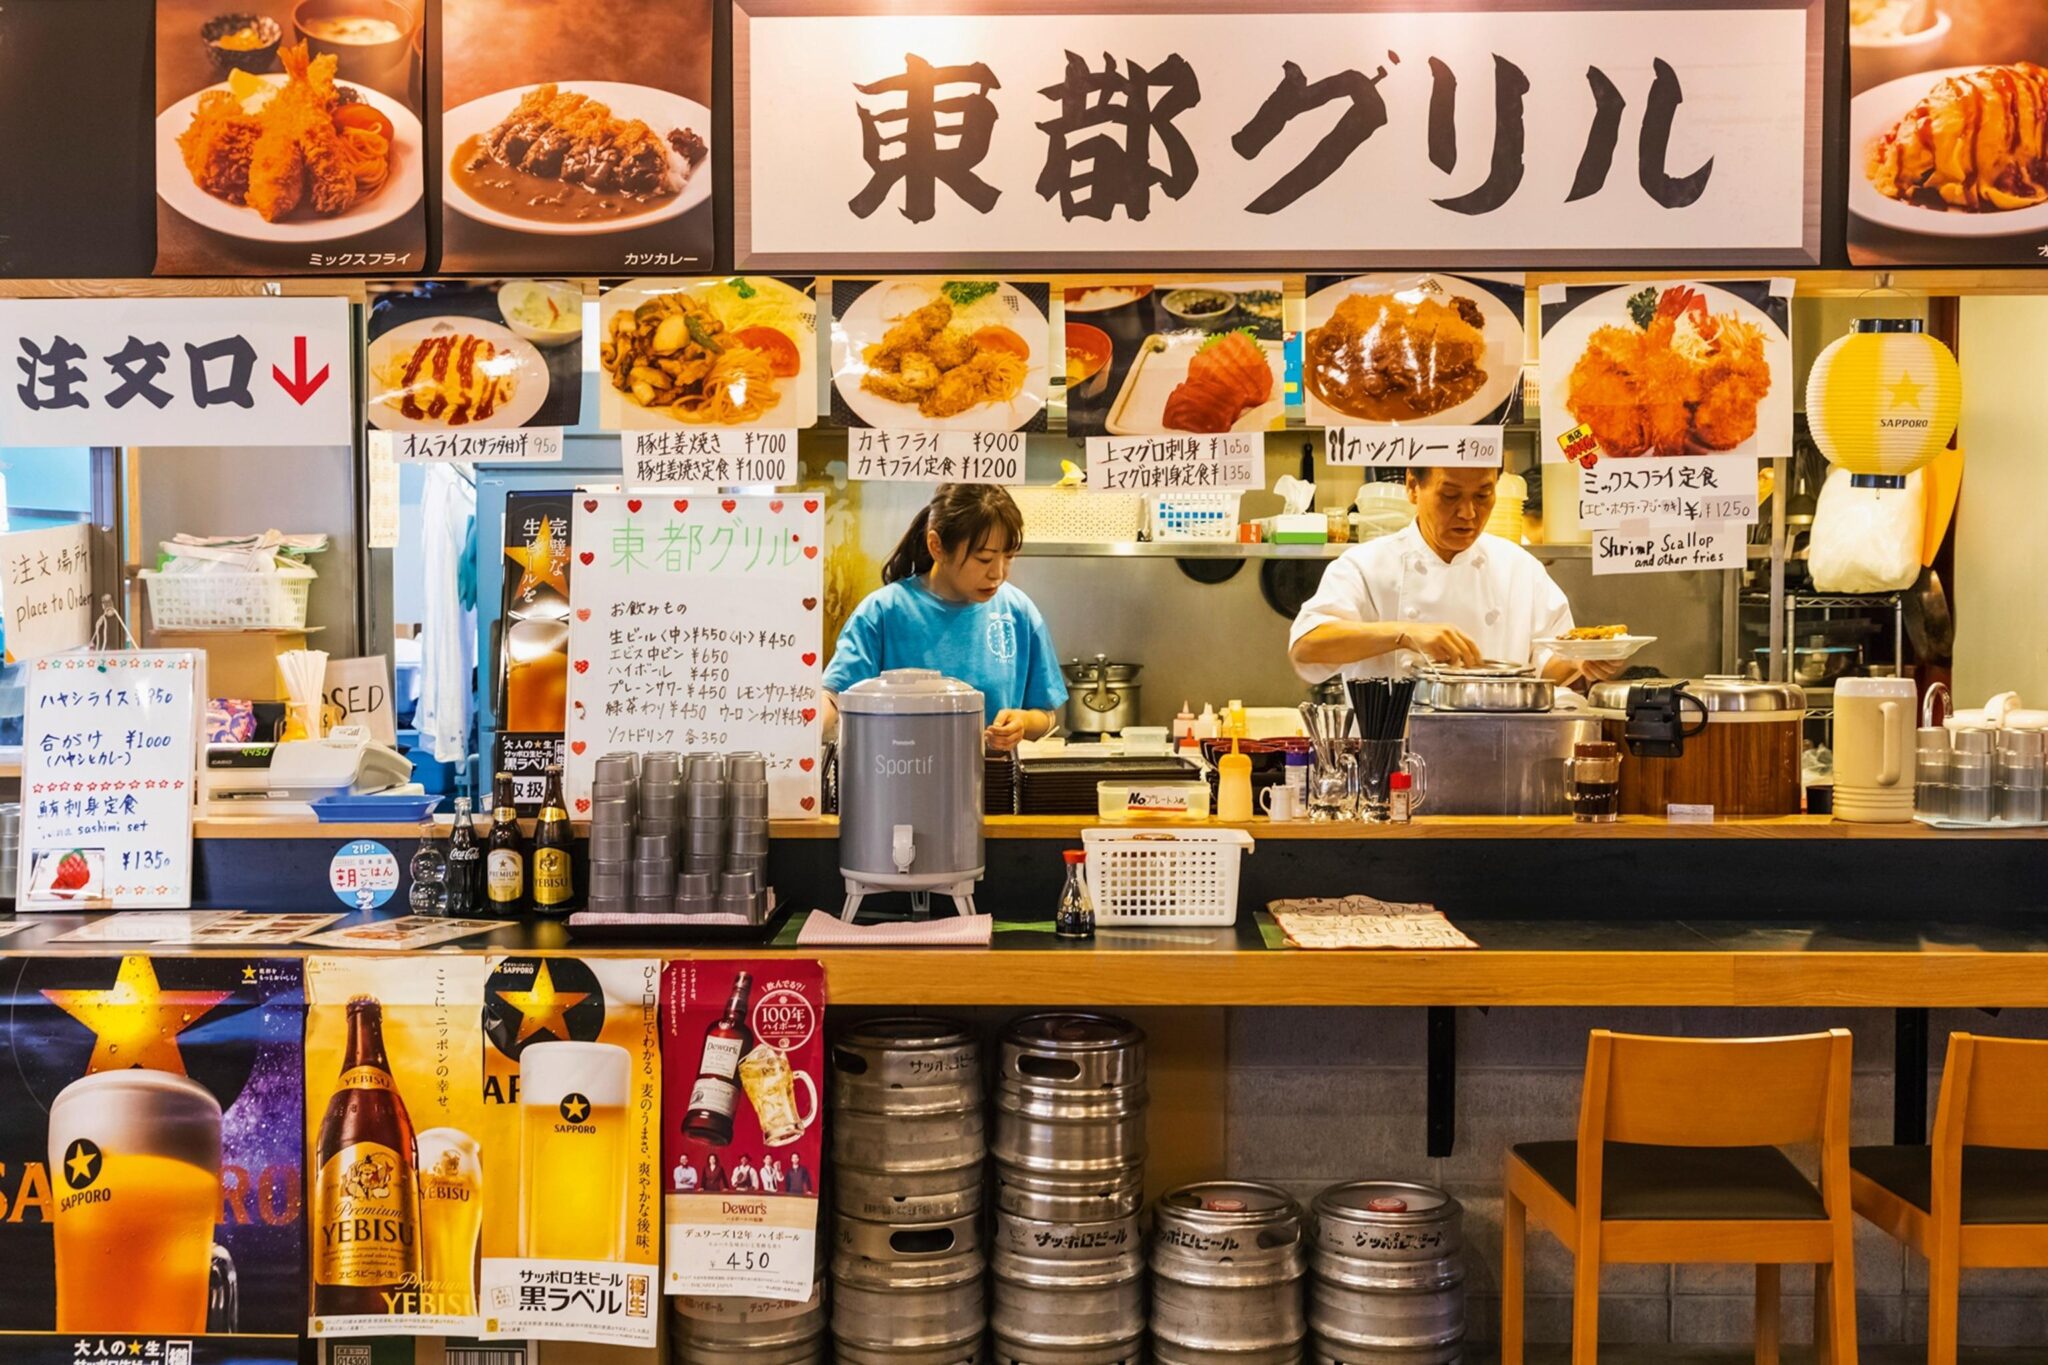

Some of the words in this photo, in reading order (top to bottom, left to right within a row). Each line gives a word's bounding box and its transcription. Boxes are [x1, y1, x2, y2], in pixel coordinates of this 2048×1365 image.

[848, 50, 1714, 224] 東都グリル
[308, 252, 411, 266] ミックスフライ
[624, 252, 698, 265] カツカレー
[17, 335, 257, 411] 注文口
[1880, 418, 1928, 428] SAPPORO
[636, 431, 721, 456] 豚生姜焼き
[744, 432, 786, 454] ¥700
[857, 431, 939, 452] カキフライ
[973, 432, 1019, 453] ¥900
[1101, 438, 1200, 464] 上マグロ刺身
[1346, 432, 1449, 462] カツカレー
[1457, 438, 1495, 460] ¥900
[636, 457, 729, 481] 豚生姜焼き定食
[857, 455, 956, 478] カキフライ定食
[962, 458, 1017, 480] ¥1200
[1584, 465, 1718, 494] ミックスフライ定食
[548, 518, 568, 576] 完璧な
[610, 517, 802, 574] 東都グリル
[1600, 537, 1655, 558] Shrimp
[1661, 532, 1714, 552] Scallop
[11, 545, 89, 585] 注文場所
[522, 518, 541, 603] 生ビールを
[1635, 554, 1655, 568] and
[1657, 554, 1687, 566] other
[1693, 550, 1724, 564] fries
[51, 594, 64, 616] to
[67, 585, 93, 611] Order
[610, 600, 687, 618] お飲みもの
[691, 650, 729, 664] ¥650
[608, 664, 673, 678] ハイボール
[691, 668, 730, 682] ¥450
[40, 689, 129, 708] ハヤシライス
[687, 685, 727, 700] ¥450
[669, 702, 706, 721] ¥450
[40, 731, 103, 752] 合がけ
[126, 730, 171, 750] ¥1000
[608, 726, 674, 744] ソフトドリンク
[504, 750, 553, 758] サッポロ生ビール
[875, 754, 934, 779] Sportif
[78, 820, 120, 835] sashimi
[127, 820, 148, 832] set
[352, 844, 376, 854] ZIP!
[763, 1007, 805, 1022] 100年
[763, 1022, 805, 1031] ハイボール
[344, 1075, 390, 1088] YEBISU
[554, 1124, 596, 1134] SAPPORO
[60, 1188, 111, 1213] SAPPORO
[332, 1201, 402, 1219] Premium
[722, 1201, 767, 1215] Dewar's
[322, 1219, 414, 1247] YEBISU
[685, 1229, 752, 1240] デュワーズ12年
[757, 1232, 800, 1242] ハイボール
[727, 1251, 770, 1270] 450
[519, 1270, 624, 1288] サッポロ生ビール
[519, 1286, 622, 1315] 黒ラベル
